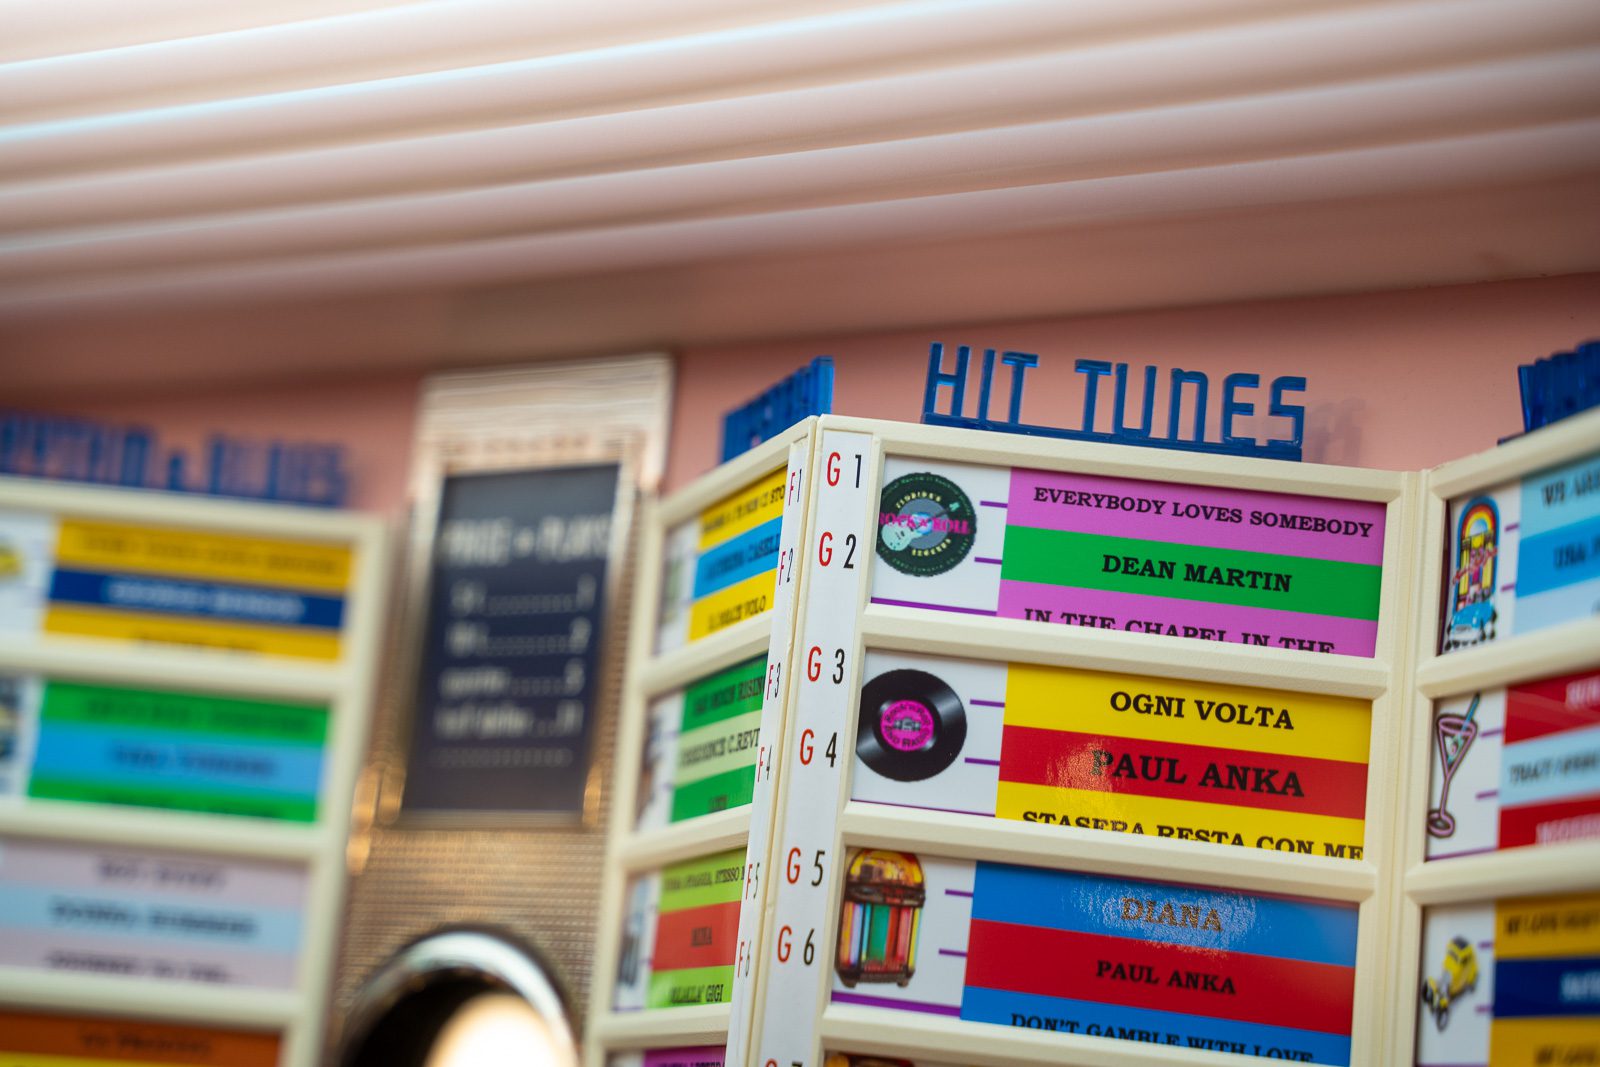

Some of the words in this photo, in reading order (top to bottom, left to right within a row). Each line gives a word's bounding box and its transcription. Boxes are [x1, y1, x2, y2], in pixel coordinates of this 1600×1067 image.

[922, 342, 1039, 424] HIT
[788, 472, 796, 506] F
[826, 452, 841, 487] G
[855, 454, 862, 488] 1
[1033, 487, 1167, 515] EVERYBODY
[1172, 503, 1243, 524] LOVES
[1250, 511, 1374, 537] SOMEBODY
[779, 551, 787, 586] F
[786, 548, 793, 582] 2
[818, 532, 833, 567] G
[843, 534, 857, 569] 2
[1102, 554, 1176, 580] DEAN
[1183, 563, 1292, 593] MARTIN
[1024, 608, 1052, 623] IN
[1060, 613, 1116, 630] THE
[1125, 620, 1232, 642] CHAPEL
[1241, 632, 1272, 646] IN
[1278, 638, 1335, 653] THE
[766, 664, 774, 700] F
[774, 662, 781, 698] 3
[807, 646, 822, 682] G
[832, 648, 845, 684] 3
[1110, 691, 1185, 718] OGNI
[1194, 700, 1294, 730] VOLTA
[758, 747, 765, 782] F
[800, 729, 814, 765] G
[825, 732, 837, 768] 4
[1090, 749, 1187, 784] PAUL
[1198, 763, 1304, 797] ANKA
[1022, 811, 1145, 834] STASERA
[1156, 825, 1245, 847] RESTA
[1256, 836, 1315, 855] CON
[1323, 843, 1363, 860] ME
[745, 864, 753, 900] F
[753, 862, 760, 899] 5
[786, 847, 801, 884] G
[811, 850, 825, 886] 5
[1120, 897, 1222, 932] DIANA
[737, 941, 745, 978] F
[777, 925, 792, 963] G
[803, 928, 815, 965] 6
[1096, 960, 1159, 984] PAUL
[1168, 971, 1237, 995] ANKA
[1011, 1013, 1079, 1034] DON'T
[1086, 1024, 1180, 1047] GAMBLE
[1187, 1036, 1247, 1055] WITH
[1253, 1044, 1313, 1063] LOVE
